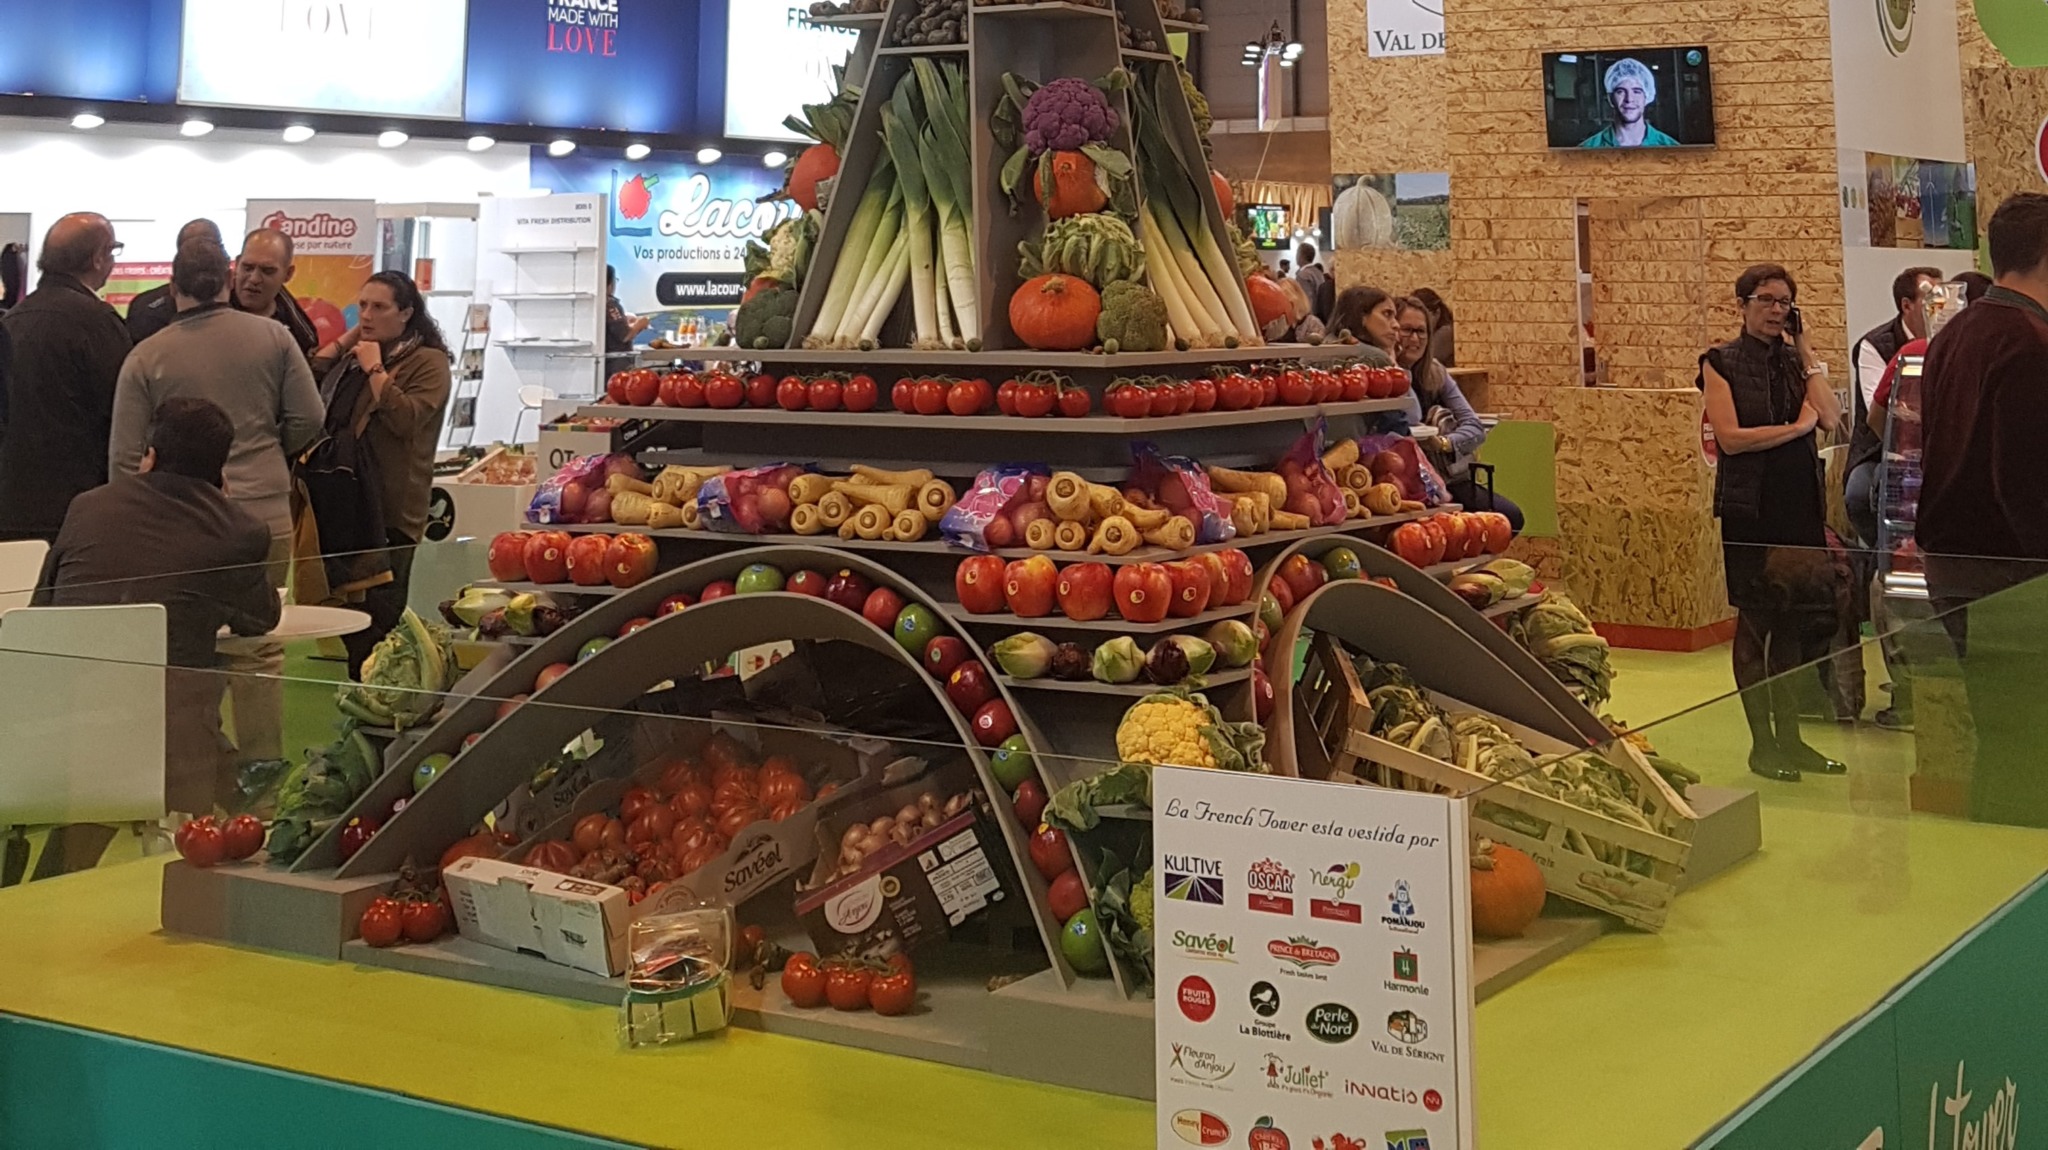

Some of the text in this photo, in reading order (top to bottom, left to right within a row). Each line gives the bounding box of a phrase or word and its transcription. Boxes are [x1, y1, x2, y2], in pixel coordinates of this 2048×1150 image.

[548, 7, 618, 28] MADE WITH
[548, 23, 617, 56] LOVE
[1373, 30, 1415, 51] VAL
[634, 245, 654, 259] Vos
[657, 246, 721, 262] productions
[725, 246, 731, 260] à
[1165, 798, 1439, 851] La French Tower esta vestida por
[1164, 854, 1223, 877] KULTIVE
[1248, 869, 1293, 894] OSCAR
[1172, 930, 1236, 954] Savéol
[1183, 988, 1211, 999] FRUITS
[1183, 995, 1211, 1006] ROUGES
[1315, 1008, 1349, 1023] Perle
[1239, 1024, 1250, 1035] La
[1320, 1022, 1353, 1035] Nord
